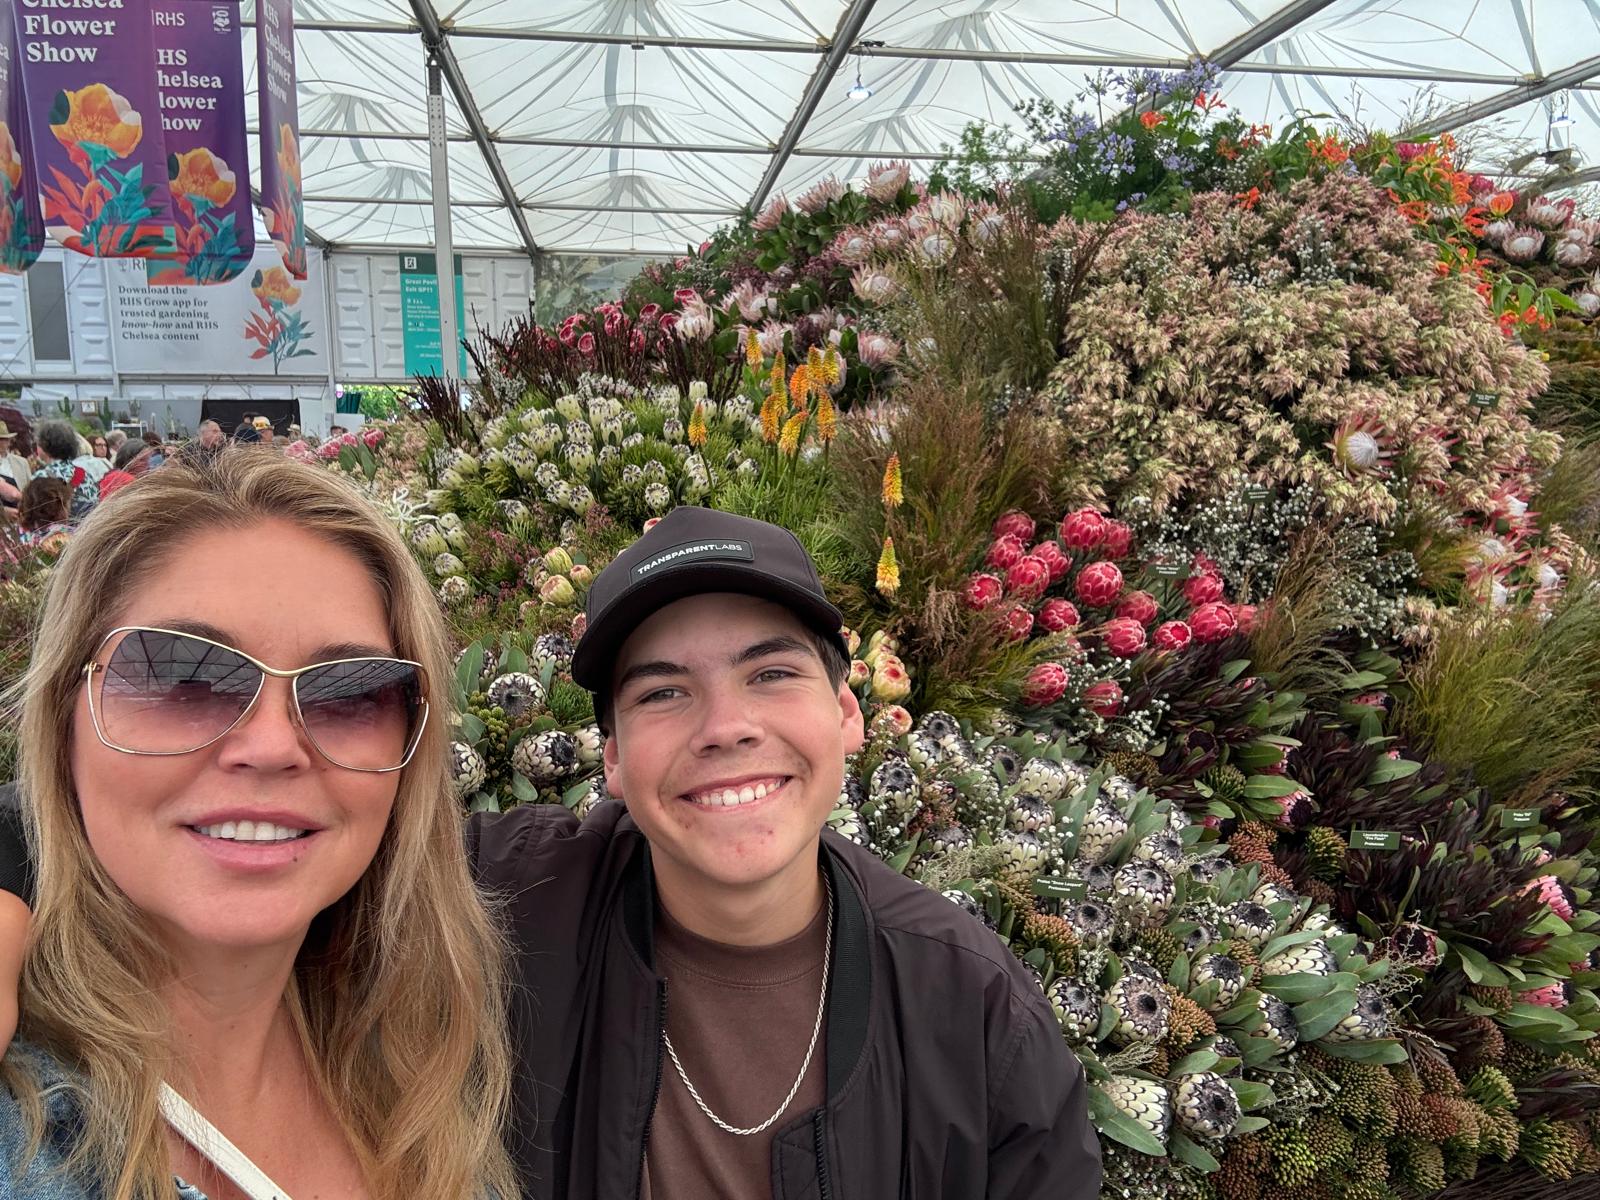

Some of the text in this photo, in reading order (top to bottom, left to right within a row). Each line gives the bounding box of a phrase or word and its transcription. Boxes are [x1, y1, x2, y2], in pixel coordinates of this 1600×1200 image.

[24, 14, 116, 35] Flower
[155, 12, 186, 26] RHS
[26, 41, 98, 62] Show
[264, 24, 293, 65] Chelsea
[157, 49, 188, 66] HS
[266, 47, 291, 85] Flower
[157, 70, 223, 88] helsea
[267, 72, 287, 104] Show
[159, 91, 216, 110] lower
[161, 113, 201, 131] how
[118, 286, 188, 295] Download the
[119, 297, 208, 308] RHS Grow app for
[120, 309, 209, 320] trusted gardening
[121, 320, 219, 330] know-how and RHS
[122, 331, 200, 341] Chelsea content
